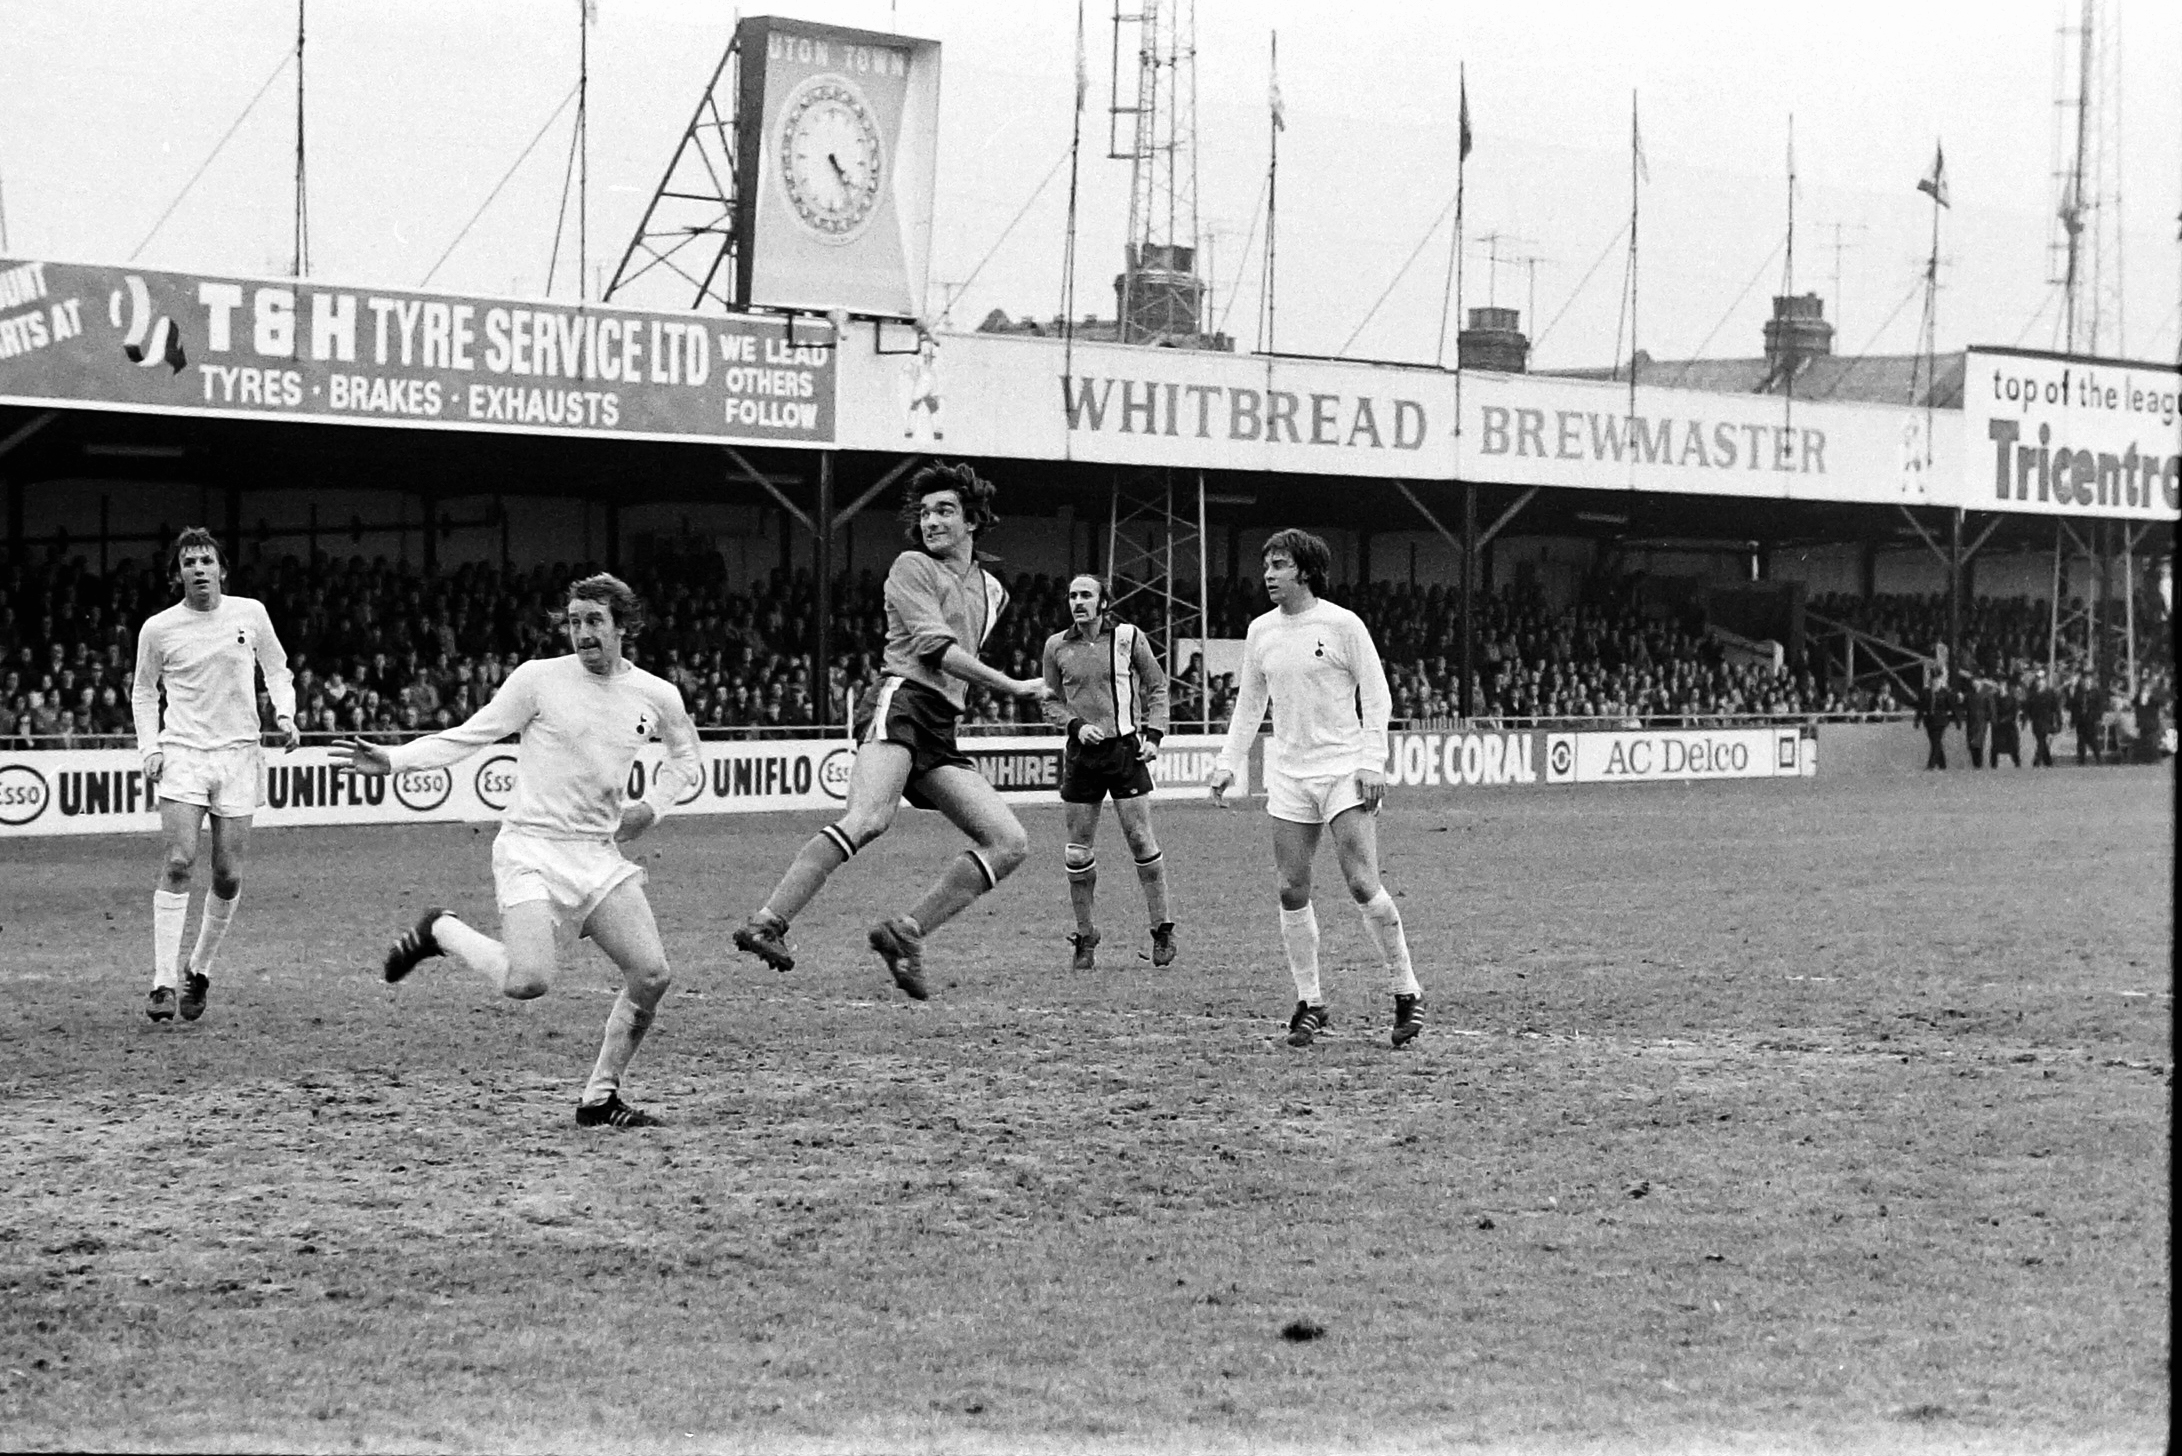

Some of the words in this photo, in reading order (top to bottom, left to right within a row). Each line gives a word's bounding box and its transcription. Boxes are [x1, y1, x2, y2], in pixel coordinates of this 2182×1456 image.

[767, 32, 828, 67] UTON
[843, 44, 904, 77] TOWN
[0, 310, 49, 359] RTS
[51, 298, 81, 341] AT
[368, 296, 475, 371] TYRE
[485, 307, 642, 383] SERVICE
[650, 319, 710, 386] LTD
[720, 334, 757, 362] WE
[765, 337, 828, 366] LEAD
[201, 364, 302, 407] TYRES
[330, 374, 442, 416] BRAKES
[468, 384, 620, 427] EXHAUSTS
[726, 366, 814, 397] OTHERS
[1993, 369, 2038, 413] top
[2045, 369, 2069, 406] of
[2079, 372, 2117, 410] the
[2126, 375, 2181, 426] leag
[725, 397, 818, 429] FOLLOW
[1060, 374, 1427, 451] WHITBREAD
[1480, 404, 1827, 475] BREWMASTER
[713, 755, 812, 798] UNIFLO
[1603, 740, 1652, 775] AC
[1660, 738, 1748, 774] Delco
[59, 771, 160, 816] UNIF
[268, 764, 385, 808] UNIFLO
